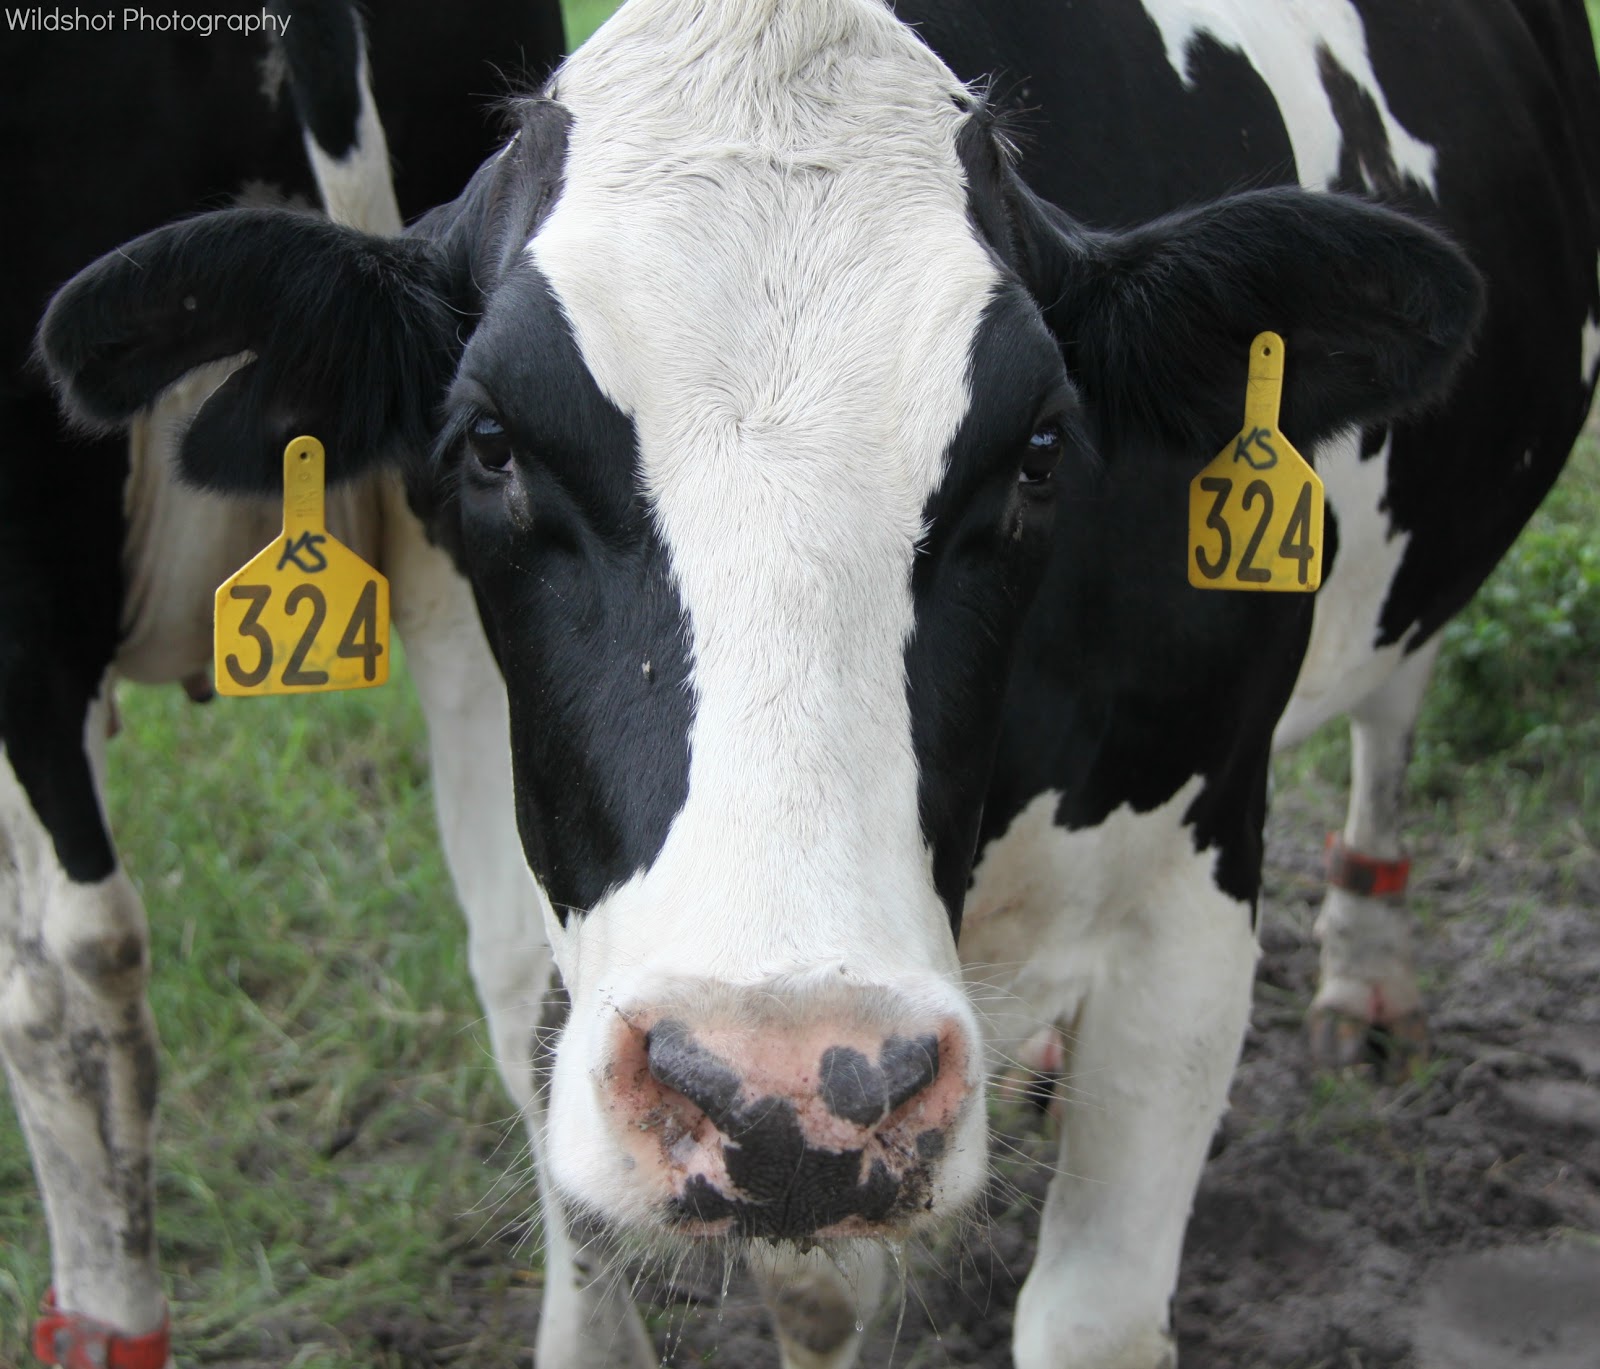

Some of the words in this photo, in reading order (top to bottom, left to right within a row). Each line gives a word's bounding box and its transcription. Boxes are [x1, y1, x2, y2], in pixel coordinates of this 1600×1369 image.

[1233, 427, 1278, 470] KS
[276, 531, 327, 573] KS
[1195, 477, 1315, 585] 324
[225, 580, 383, 687] 324
